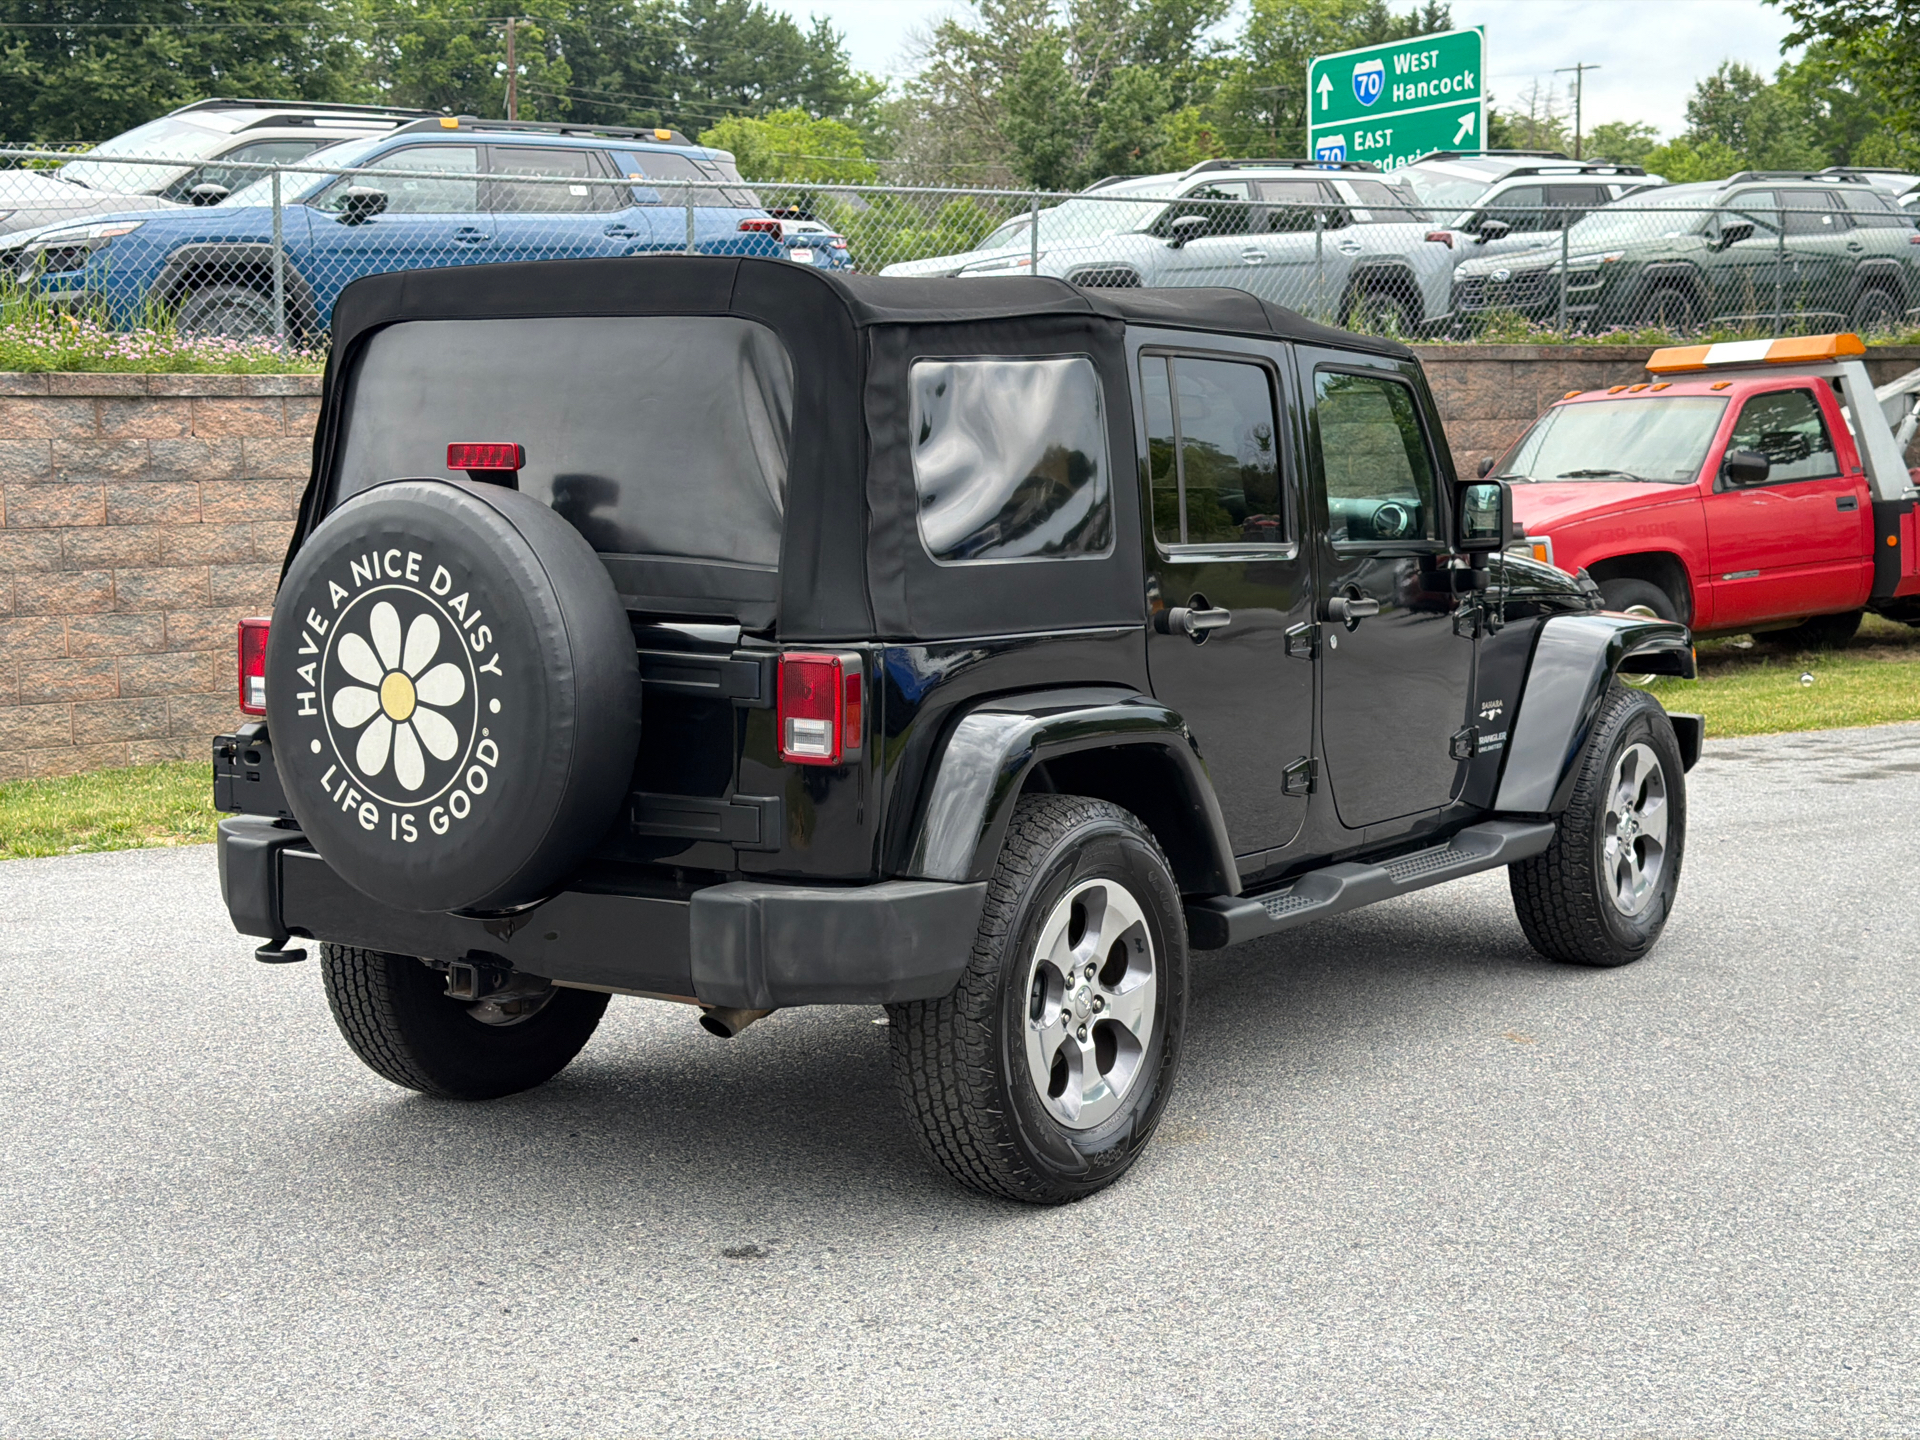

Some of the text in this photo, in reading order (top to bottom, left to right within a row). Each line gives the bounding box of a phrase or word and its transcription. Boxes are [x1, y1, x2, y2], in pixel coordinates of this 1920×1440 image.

[1394, 50, 1439, 75] WEST
[1357, 73, 1380, 97] 70
[1393, 70, 1475, 102] Hancock
[1354, 129, 1393, 151] EAST
[1320, 148, 1342, 169] 70
[1357, 147, 1438, 174] ederi
[296, 548, 503, 717] HAVE A NICE DAISY
[1482, 699, 1503, 710] SAHARA
[1478, 731, 1507, 745] RANGLER
[391, 812, 419, 843] IS
